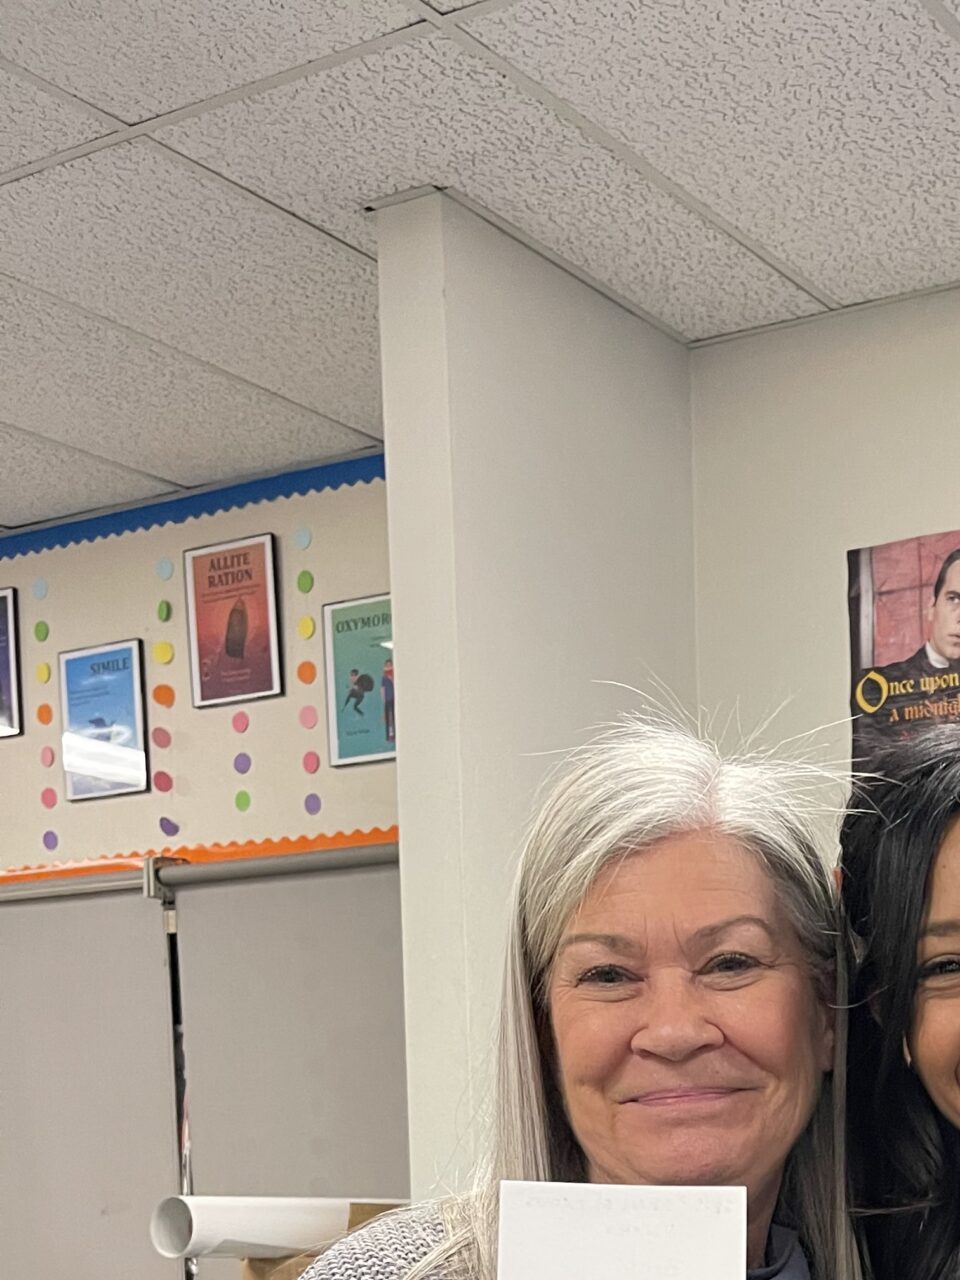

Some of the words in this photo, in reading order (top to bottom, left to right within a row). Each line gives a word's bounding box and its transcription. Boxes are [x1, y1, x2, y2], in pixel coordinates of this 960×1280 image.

[208, 552, 251, 572] ALLITE
[207, 568, 253, 589] RATION
[335, 612, 392, 634] OXYMOR
[90, 657, 130, 674] SIMILE
[855, 671, 915, 714] Once
[920, 673, 960, 695] upon
